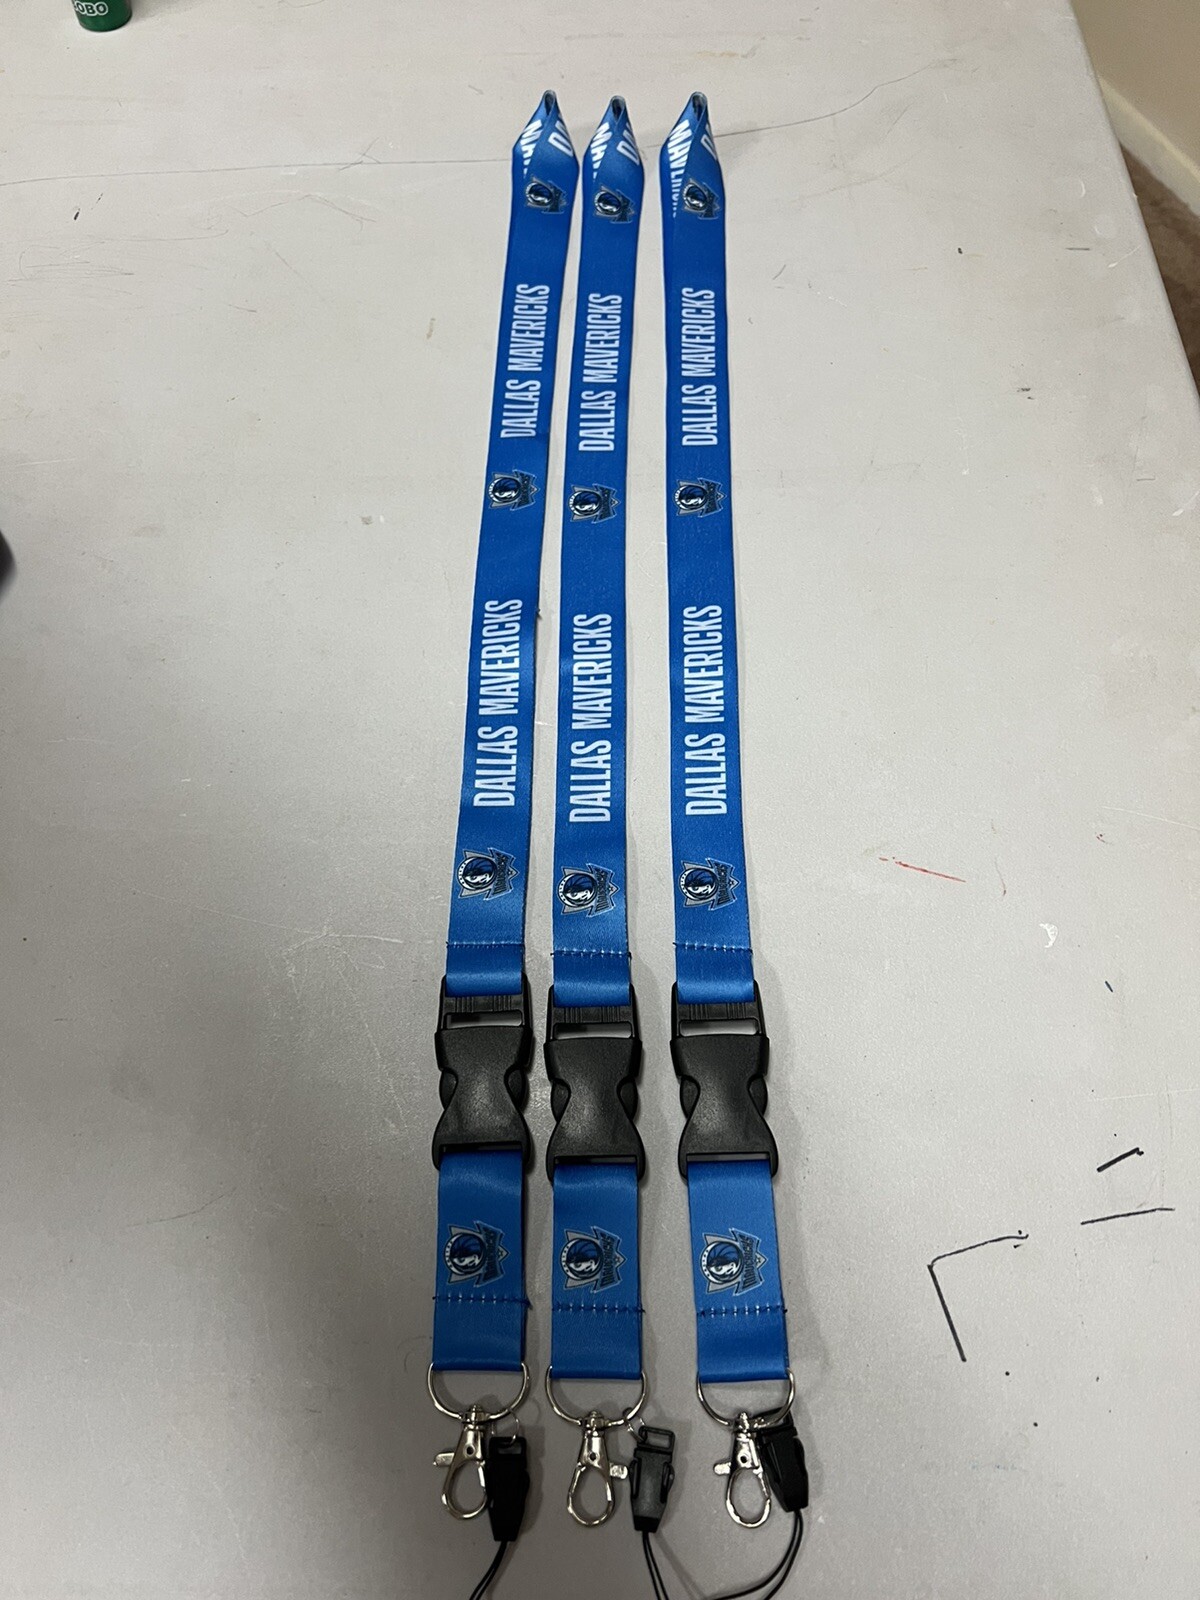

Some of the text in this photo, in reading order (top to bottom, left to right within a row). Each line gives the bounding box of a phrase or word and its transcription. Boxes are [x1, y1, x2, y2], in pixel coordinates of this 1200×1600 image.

[74, 0, 109, 16] OBO
[507, 284, 550, 372] MAVERICKS
[582, 293, 622, 383] MAVERICKS
[681, 287, 715, 377] MAVERICKS
[500, 378, 541, 438] DALLAS
[578, 390, 617, 451] DALLAS
[681, 384, 718, 446] DALLAS
[473, 599, 523, 807] DALLAS MAVERICKS
[569, 613, 612, 822] DALLAS MAVERICKS
[683, 604, 727, 816] DALLAS MAVERICKS
